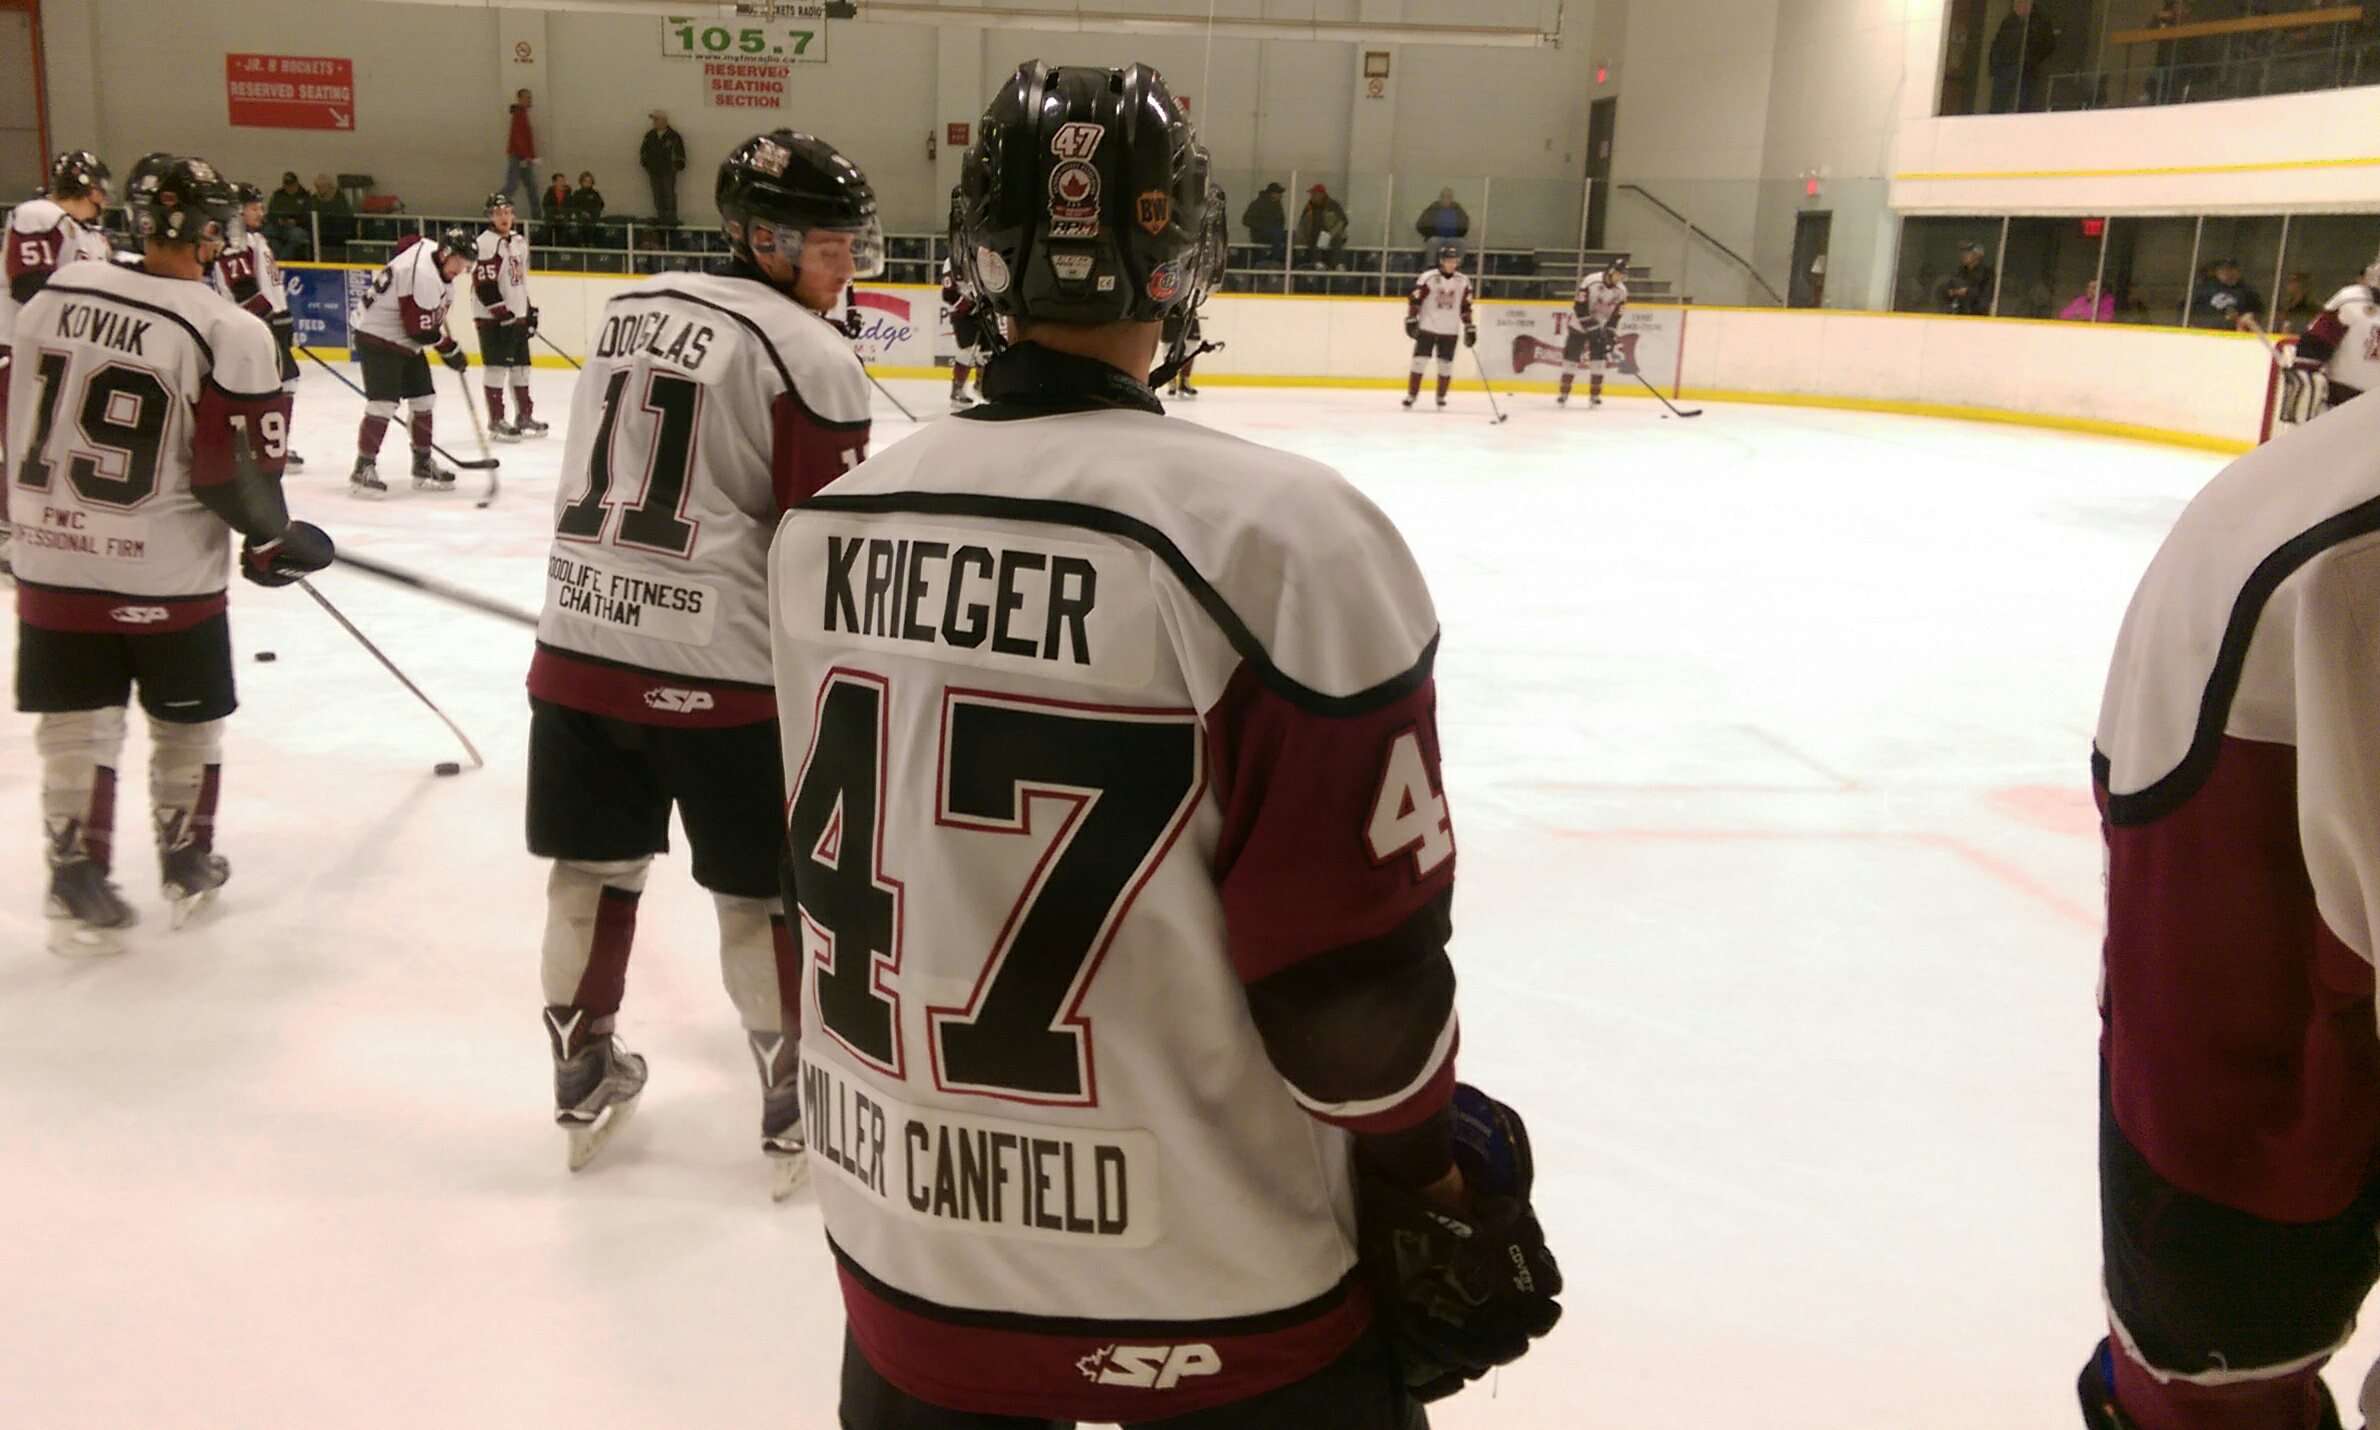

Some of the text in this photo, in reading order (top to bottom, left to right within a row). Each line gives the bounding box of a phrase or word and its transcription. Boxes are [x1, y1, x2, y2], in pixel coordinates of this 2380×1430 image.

[675, 26, 814, 55] 105.7
[705, 63, 790, 78] RESERVED
[712, 79, 784, 93] SEATING
[231, 81, 350, 101] RESERVED SEATING
[715, 94, 780, 108] SECTION
[1053, 125, 1101, 158] 47
[20, 240, 54, 266] 51
[227, 257, 251, 279] 71
[477, 264, 497, 281] 25
[57, 303, 151, 356] KOVIAK
[596, 310, 714, 371] DOUGLAS
[16, 346, 175, 512] 19
[229, 410, 286, 460] 19
[554, 364, 705, 560] 11
[43, 506, 87, 530] FWC
[106, 537, 145, 558] FIRM
[559, 585, 641, 627] CHATHAM
[610, 575, 703, 614] FITNESS
[824, 535, 1098, 666] KRIEGER
[653, 688, 715, 713] SP
[785, 666, 1209, 1108] 47
[803, 1059, 1128, 1236] MILLER CANFIELD
[1098, 1343, 1222, 1389] SP
